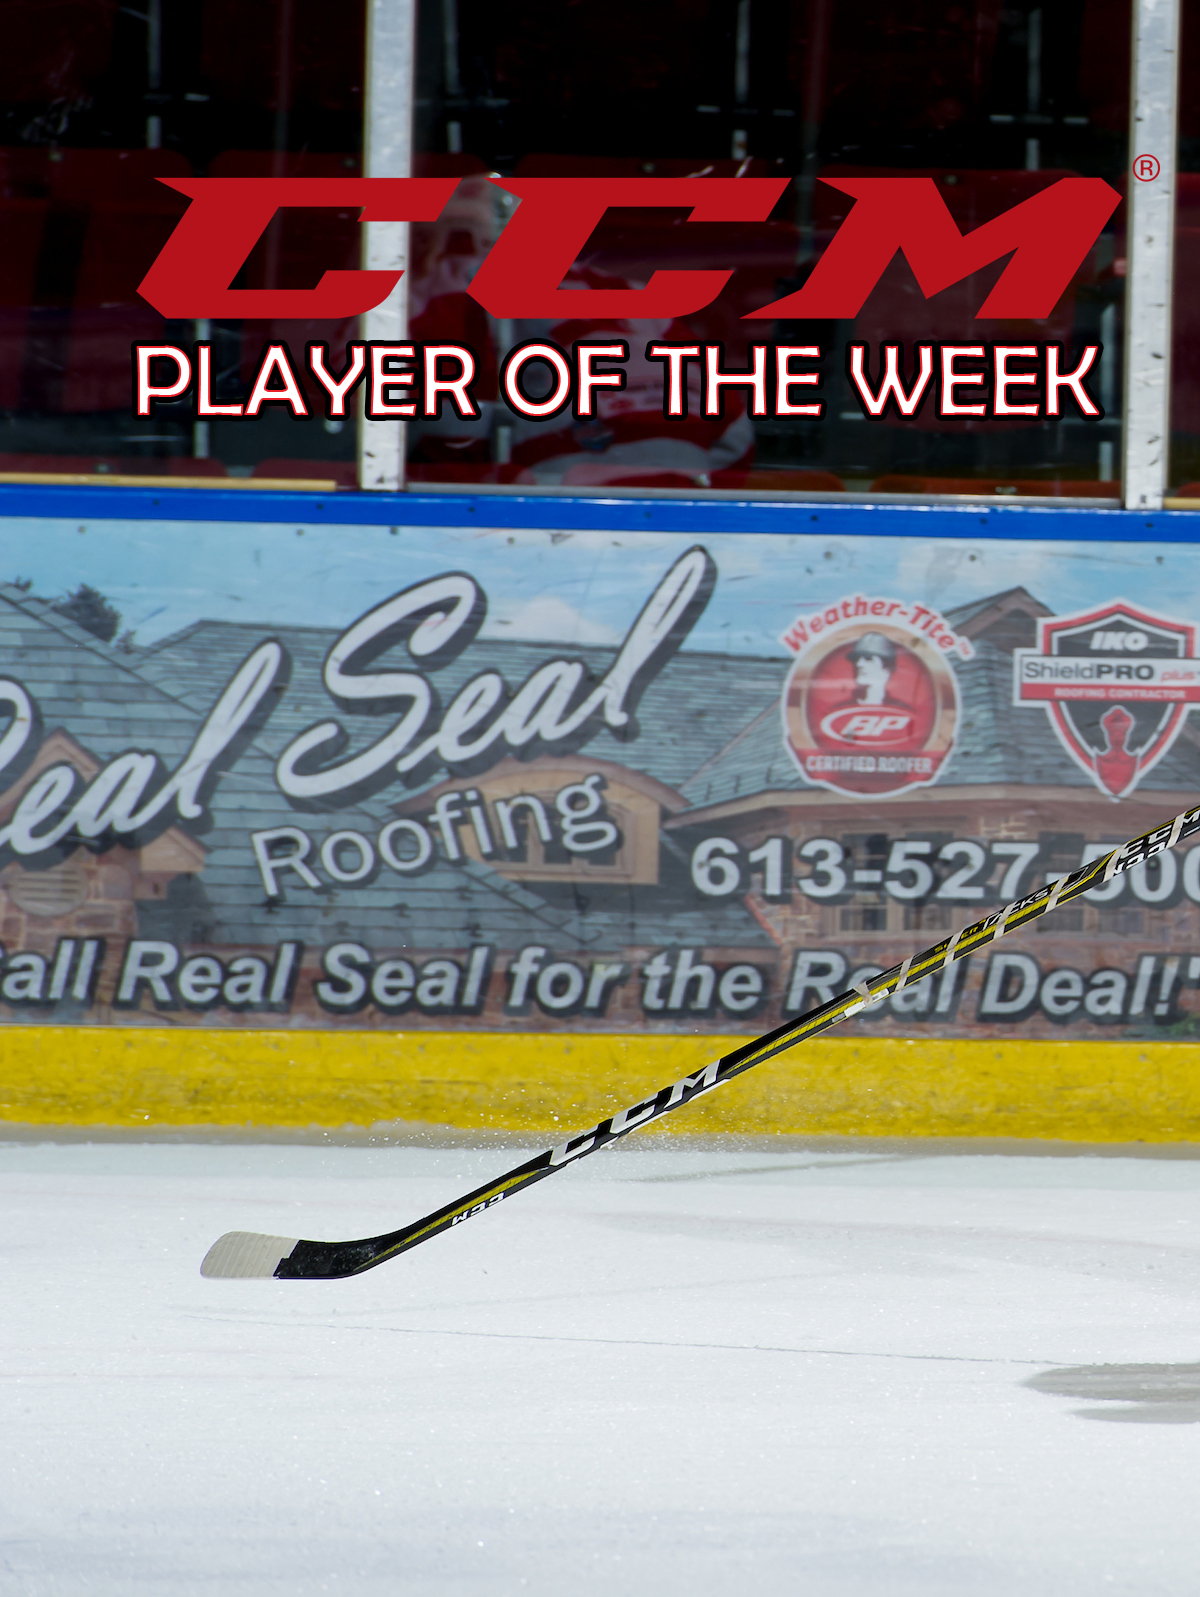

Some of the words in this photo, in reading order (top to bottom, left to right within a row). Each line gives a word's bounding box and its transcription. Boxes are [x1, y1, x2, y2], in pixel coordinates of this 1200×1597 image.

[1090, 631, 1149, 652] IKO
[276, 546, 708, 798] Seal
[1025, 661, 1155, 681] ShieldPRO
[1054, 687, 1106, 698] ROOFING
[1108, 688, 1186, 699] CONTRACTOR
[841, 715, 912, 737] BP
[806, 755, 876, 773] CERTIFIED
[878, 756, 933, 774] ROOFER
[252, 775, 617, 897] Roofing
[2, 939, 99, 1000] all
[119, 940, 298, 1003] Real
[317, 943, 489, 1005] Seal
[509, 945, 621, 1008] for
[643, 946, 762, 1010] the
[786, 951, 962, 1013] Real
[549, 1058, 721, 1167] CCM
[451, 1191, 505, 1227] CCM
